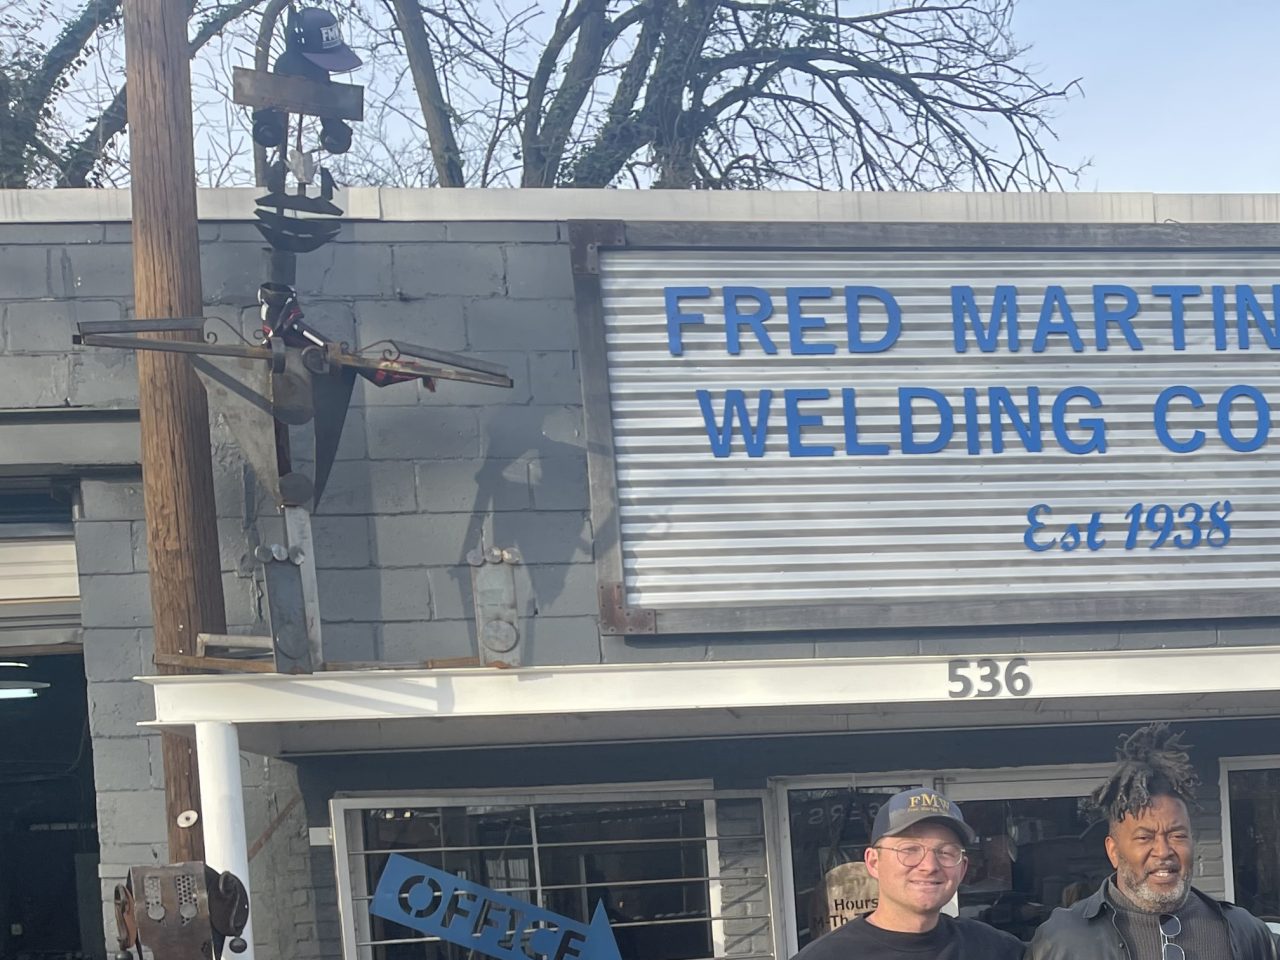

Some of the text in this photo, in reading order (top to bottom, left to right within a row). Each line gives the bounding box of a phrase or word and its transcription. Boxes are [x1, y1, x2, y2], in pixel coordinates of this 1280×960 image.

[664, 285, 903, 356] FRED
[697, 384, 1272, 457] WELDING CO
[1023, 500, 1234, 552] Est 1938
[947, 658, 1032, 698] 536
[909, 793, 950, 809] FMW
[834, 898, 878, 911] Hours
